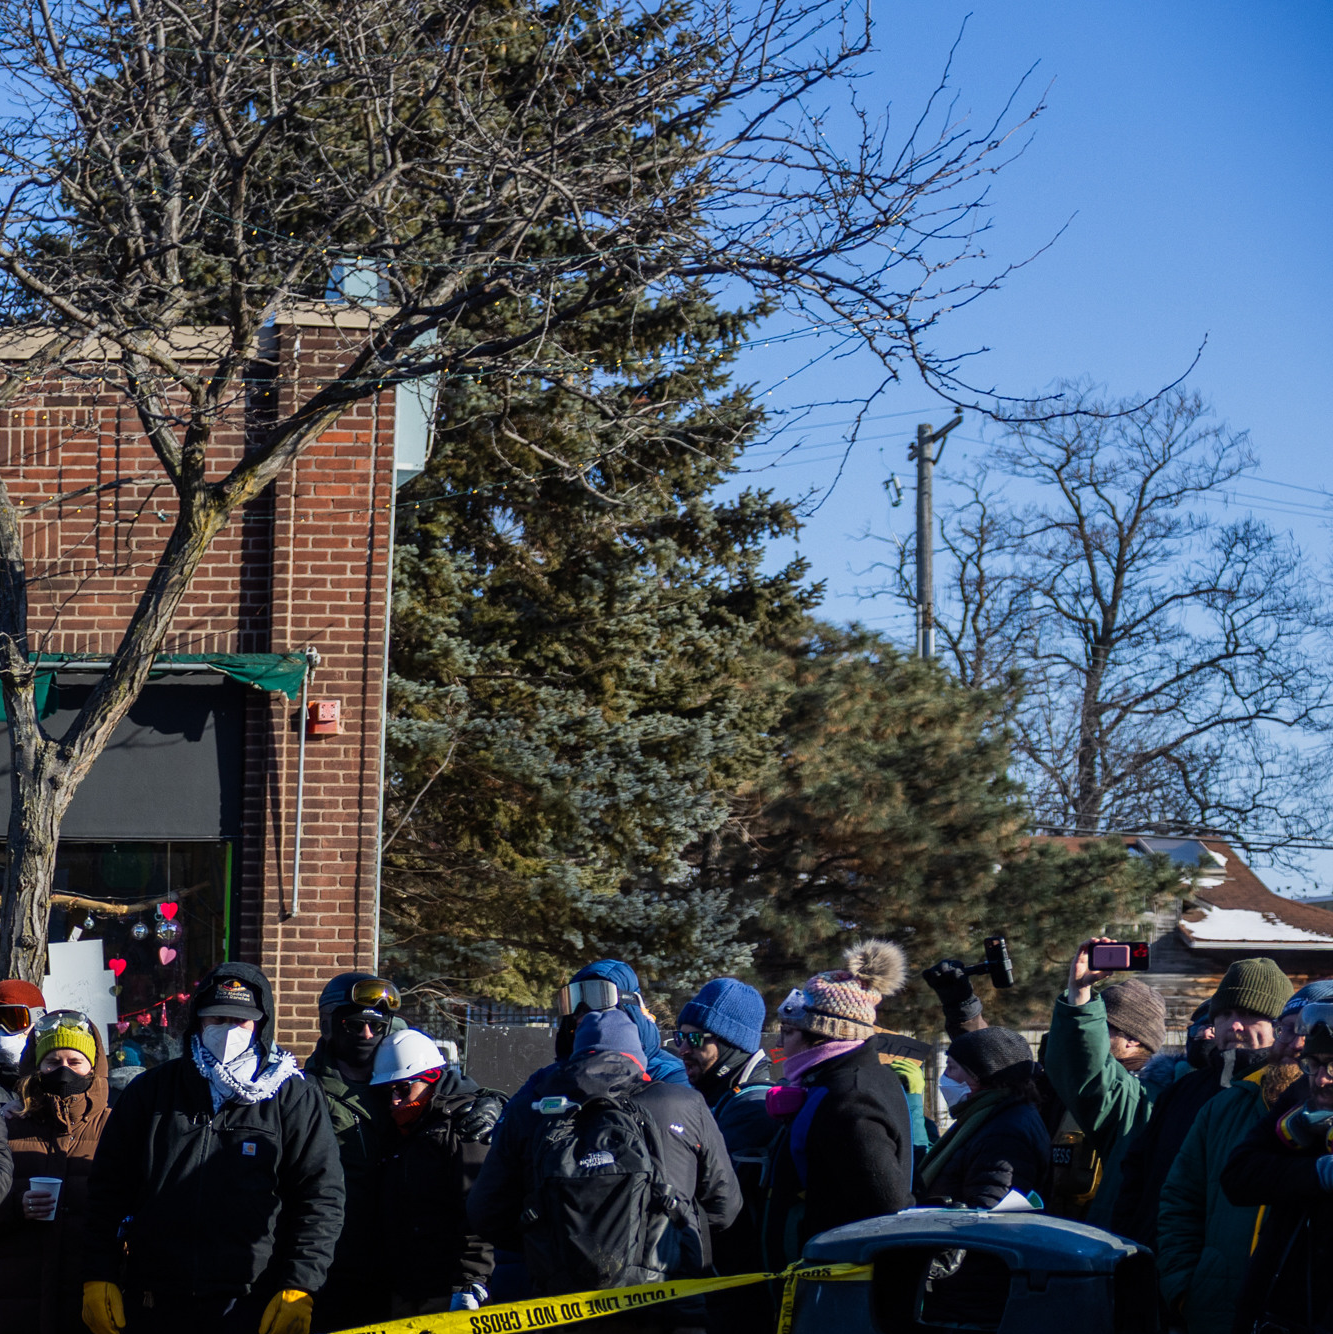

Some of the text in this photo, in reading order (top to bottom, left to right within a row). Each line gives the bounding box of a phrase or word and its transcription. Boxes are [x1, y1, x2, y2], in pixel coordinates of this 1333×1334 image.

[1053, 1148, 1071, 1163] RESS
[527, 1306, 558, 1328] NOT
[561, 1302, 584, 1320] DO
